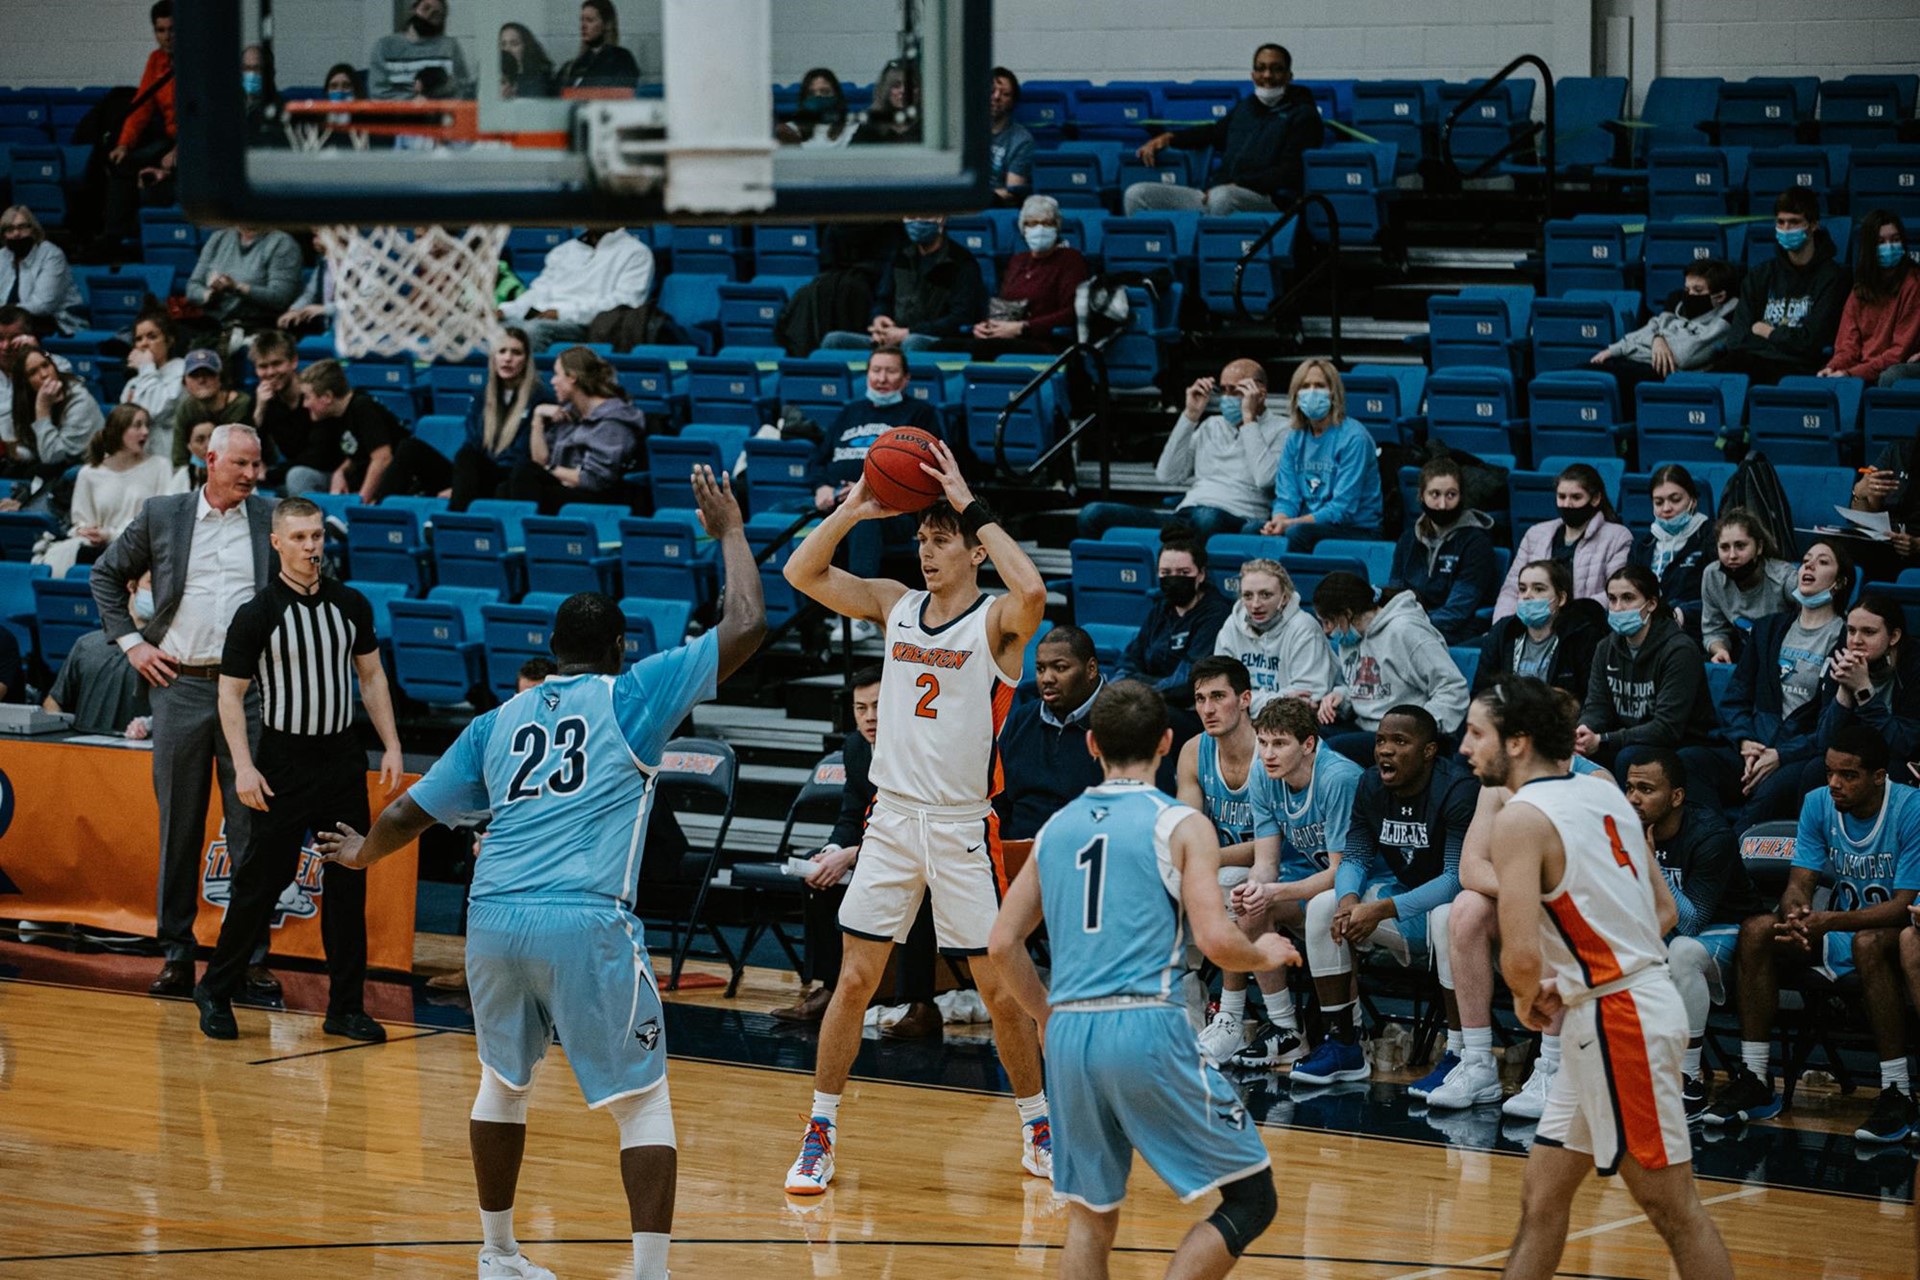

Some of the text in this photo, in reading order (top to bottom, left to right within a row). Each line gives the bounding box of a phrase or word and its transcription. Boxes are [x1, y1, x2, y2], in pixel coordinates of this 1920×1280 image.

[892, 641, 973, 671] WHEATON
[914, 672, 940, 720] 2
[504, 714, 589, 804] 23
[1743, 837, 1797, 858] WHEA
[1075, 833, 1109, 934] 1
